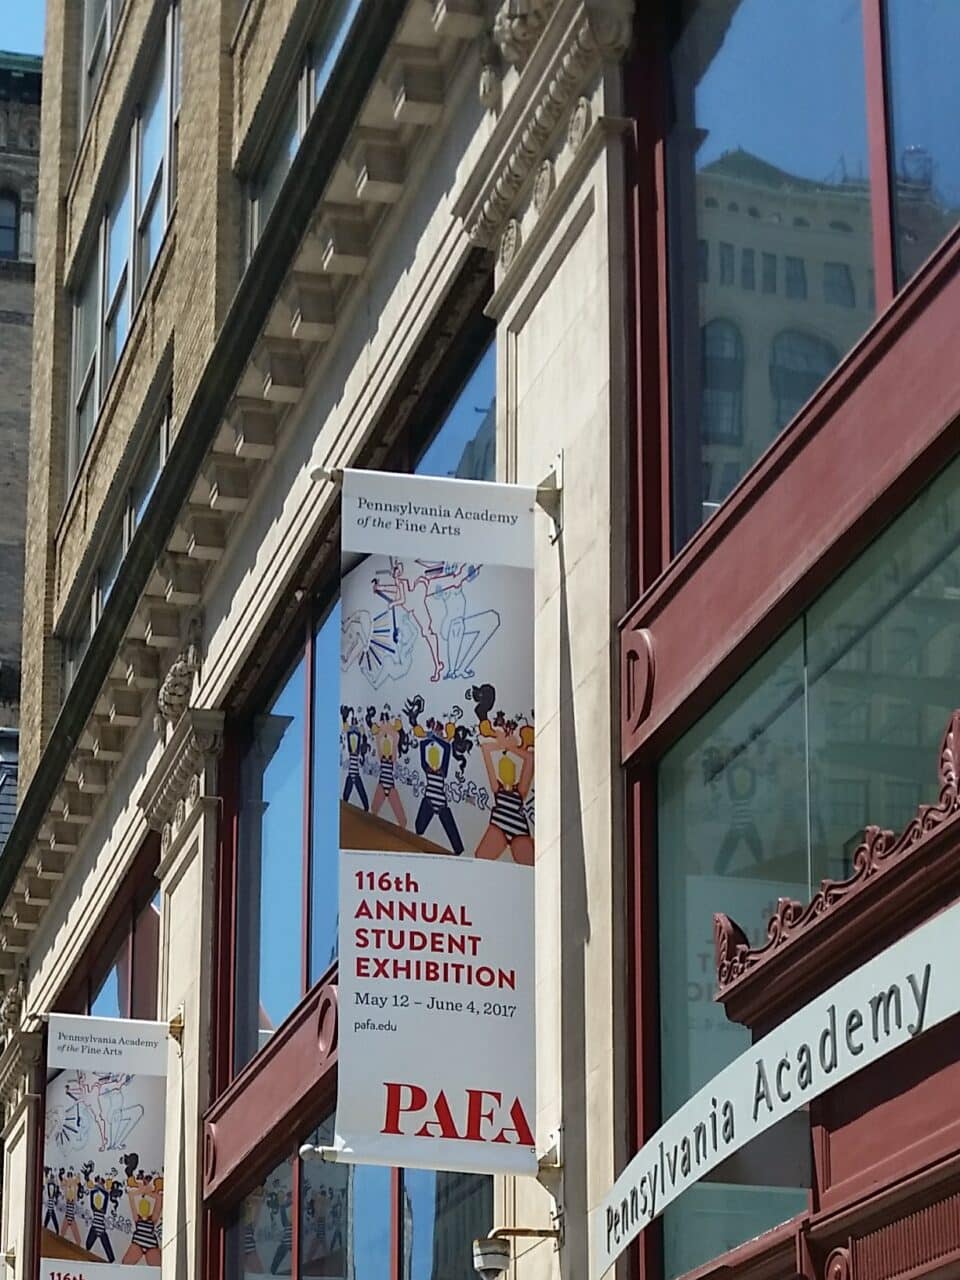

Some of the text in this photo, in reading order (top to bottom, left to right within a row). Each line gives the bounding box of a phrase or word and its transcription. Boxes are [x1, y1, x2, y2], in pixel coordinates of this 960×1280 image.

[358, 497, 519, 526] Pennsylvania Academy
[357, 516, 461, 536] of the Fine Arts
[355, 870, 419, 893] 116th
[354, 899, 472, 927] ANNUAL
[355, 928, 482, 957] STUDENT
[356, 957, 515, 990] EXHIBITION
[354, 992, 388, 1009] May
[392, 995, 410, 1008] 12
[427, 997, 462, 1012] June
[467, 1001, 480, 1016] 4,
[483, 1003, 517, 1018] 2017
[353, 1020, 397, 1032] pafa.edu
[57, 1044, 122, 1055] of the Fine Arts
[58, 1032, 159, 1048] Pennsylvania Academy
[380, 1082, 535, 1146] PAFA
[605, 963, 931, 1255] Pennsylvania Academy
